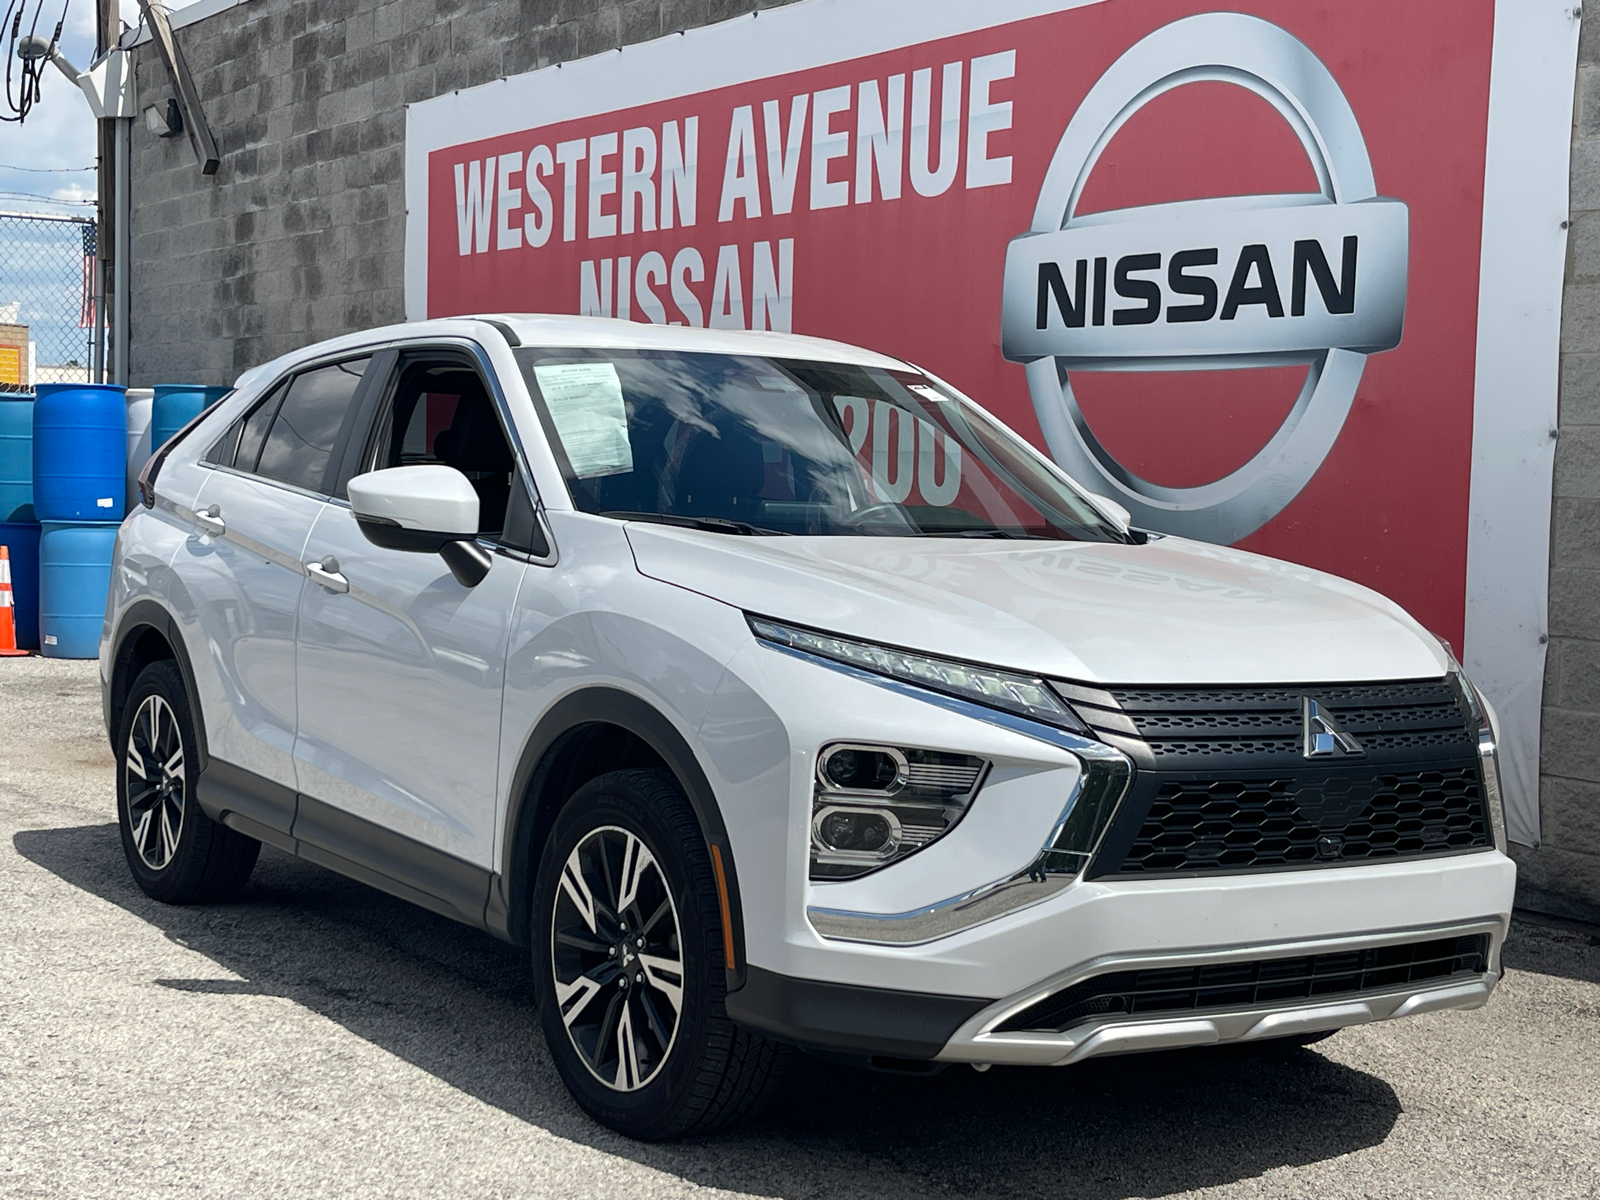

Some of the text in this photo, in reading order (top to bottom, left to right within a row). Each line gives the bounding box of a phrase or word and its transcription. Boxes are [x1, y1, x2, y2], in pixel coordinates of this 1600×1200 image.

[454, 49, 1017, 257] WESTERN AVENUE
[580, 238, 795, 334] NISSAN
[1036, 235, 1358, 330] NISSAN
